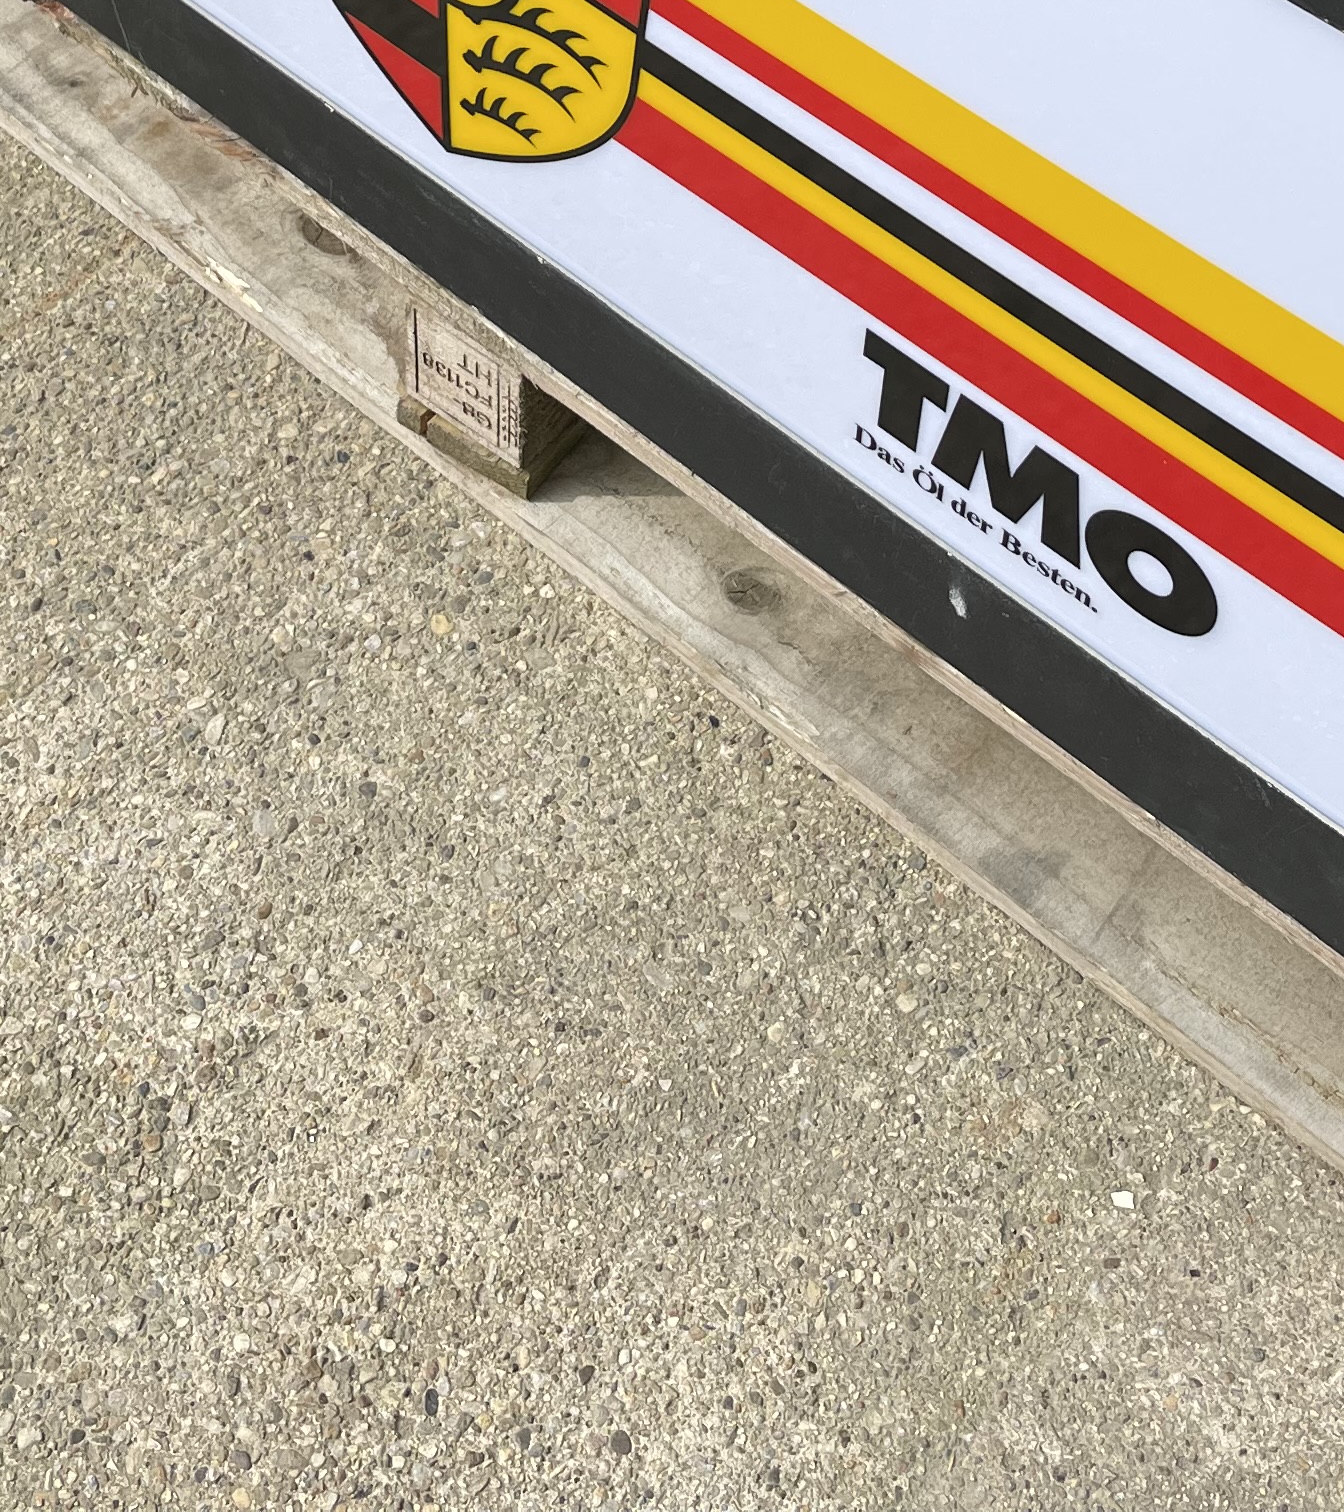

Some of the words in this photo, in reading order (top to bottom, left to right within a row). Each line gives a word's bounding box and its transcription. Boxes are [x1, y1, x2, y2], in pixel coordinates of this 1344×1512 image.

[457, 354, 492, 387] HT
[853, 422, 905, 474] Das
[912, 465, 945, 502] Öl
[951, 497, 994, 535] der
[999, 528, 1099, 614] Besten.
[862, 328, 1218, 637] TMO
